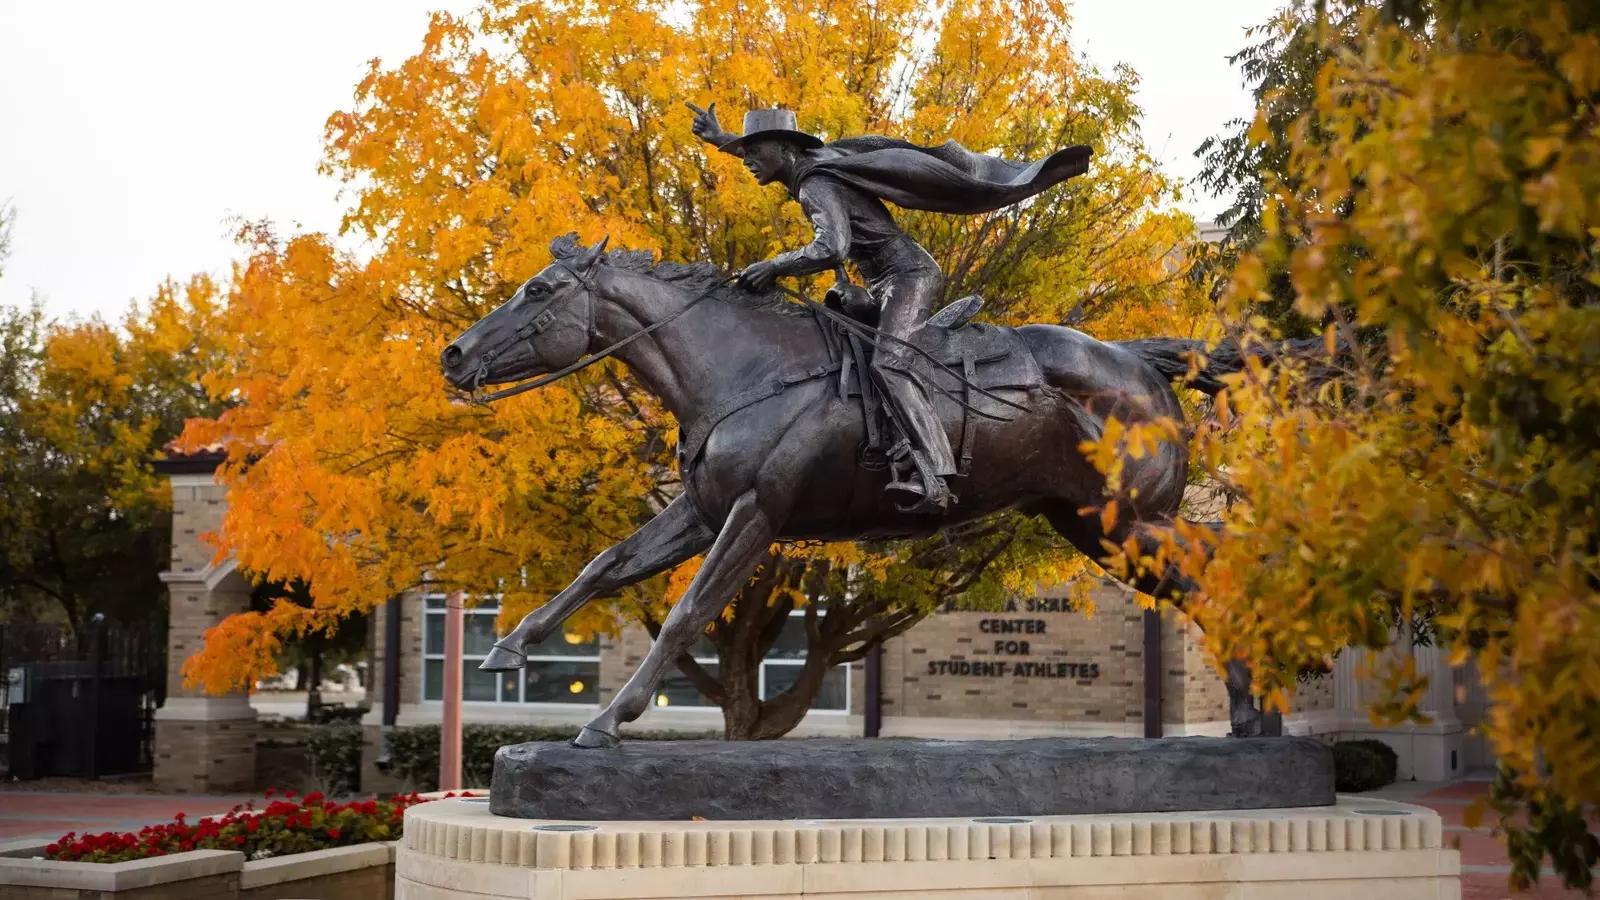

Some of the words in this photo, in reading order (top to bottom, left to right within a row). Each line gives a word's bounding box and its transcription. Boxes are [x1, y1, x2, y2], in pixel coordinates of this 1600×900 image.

[1026, 597, 1078, 613] SHAR
[979, 618, 1047, 635] CENTER
[994, 640, 1030, 655] FOR
[927, 660, 1100, 678] STUDENT-ATHLETES
